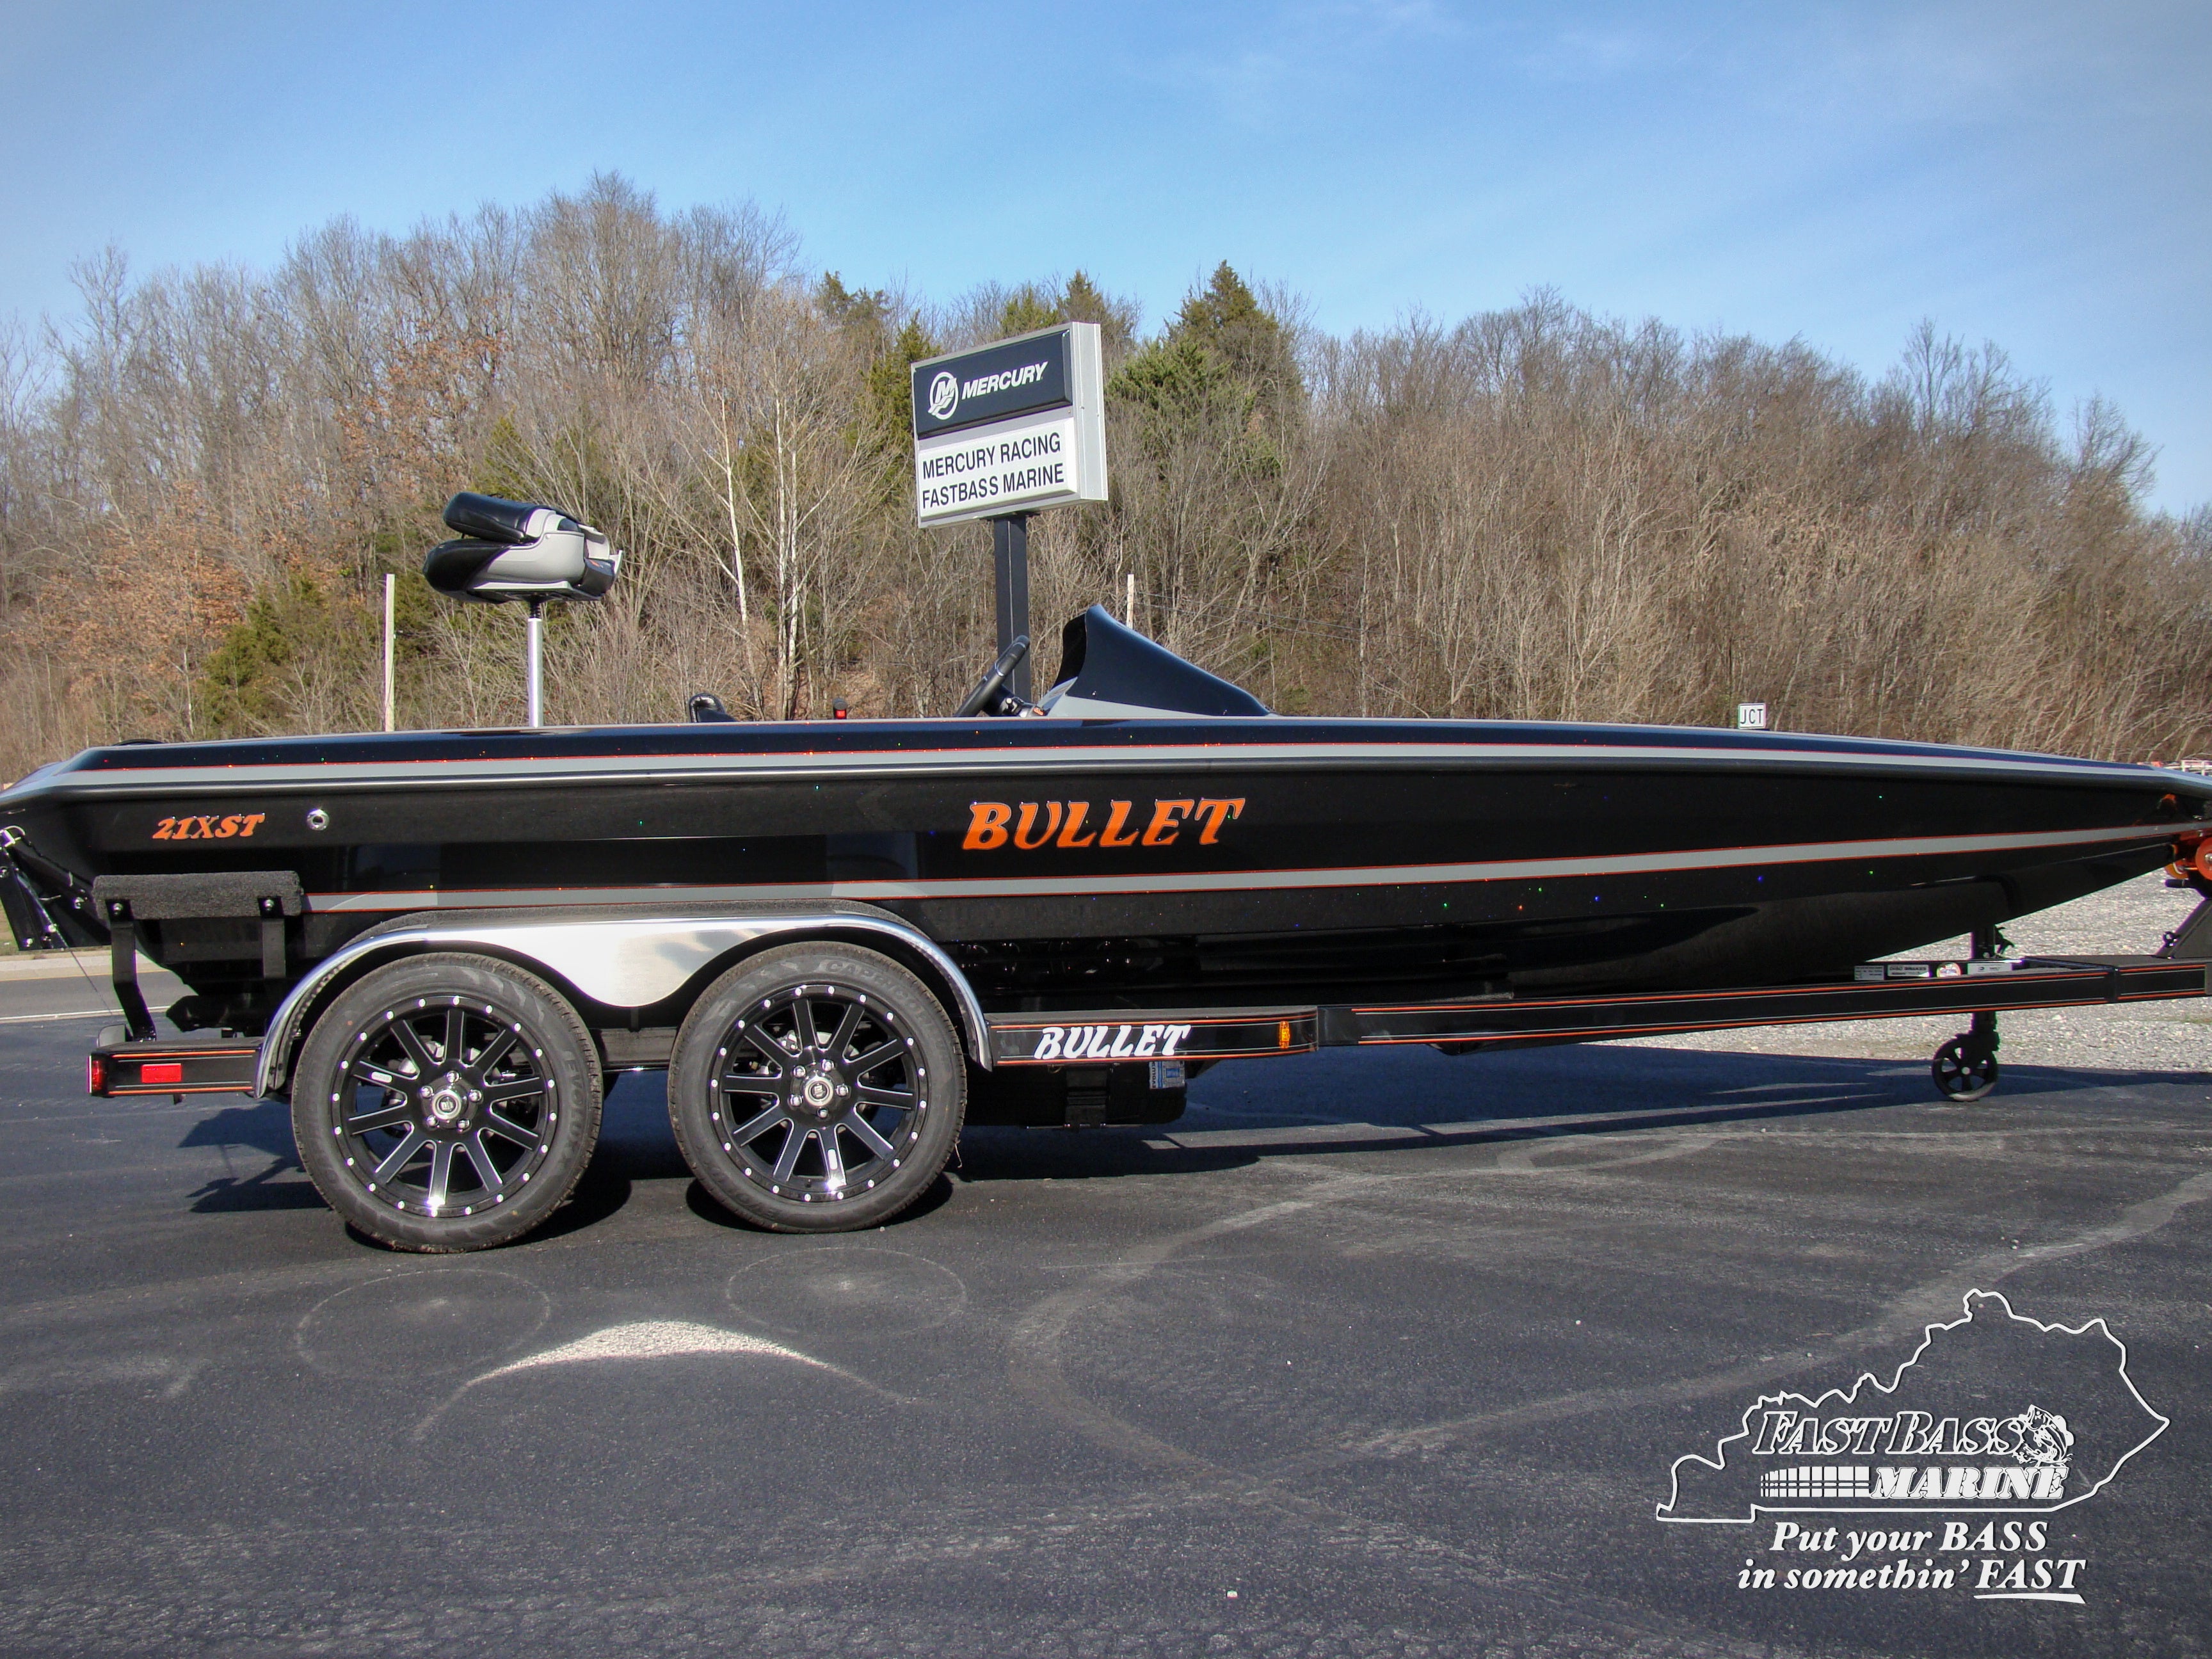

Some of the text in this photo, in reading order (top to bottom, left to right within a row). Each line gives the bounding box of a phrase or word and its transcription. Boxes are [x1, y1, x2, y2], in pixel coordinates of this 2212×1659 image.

[961, 361, 1048, 400] MERCURY
[922, 432, 1061, 479] MERCURY RACING
[922, 463, 1064, 508] FASTBASS MARINE
[1740, 709, 1763, 725] JCT
[152, 813, 266, 840] 21XST
[961, 798, 1246, 851] BULLET
[1034, 1024, 1192, 1060] BULLET
